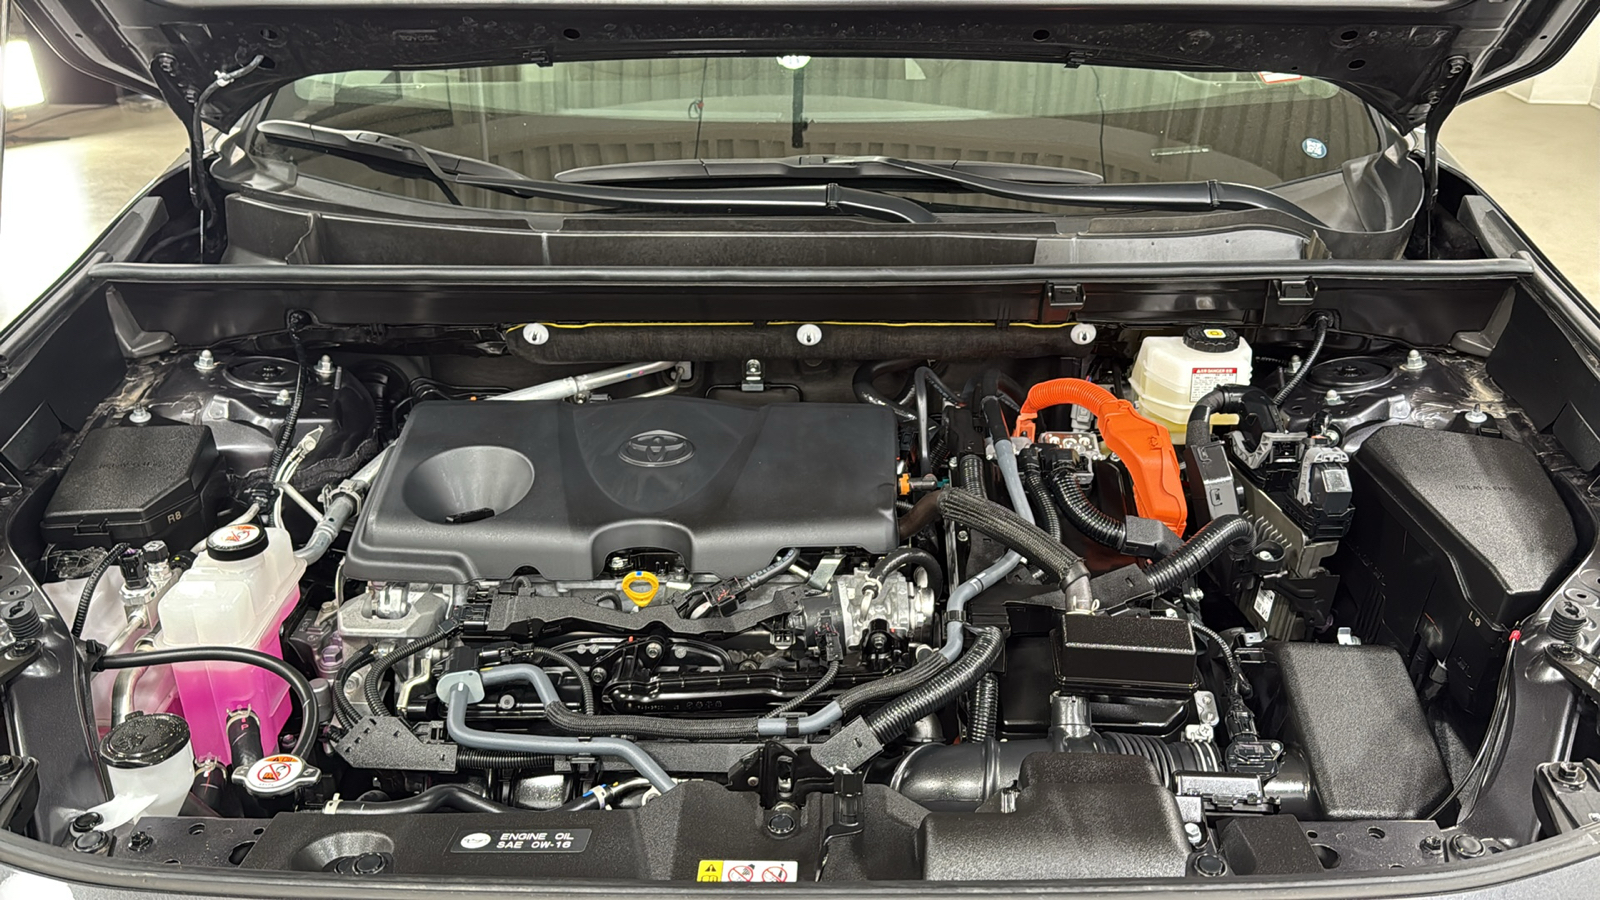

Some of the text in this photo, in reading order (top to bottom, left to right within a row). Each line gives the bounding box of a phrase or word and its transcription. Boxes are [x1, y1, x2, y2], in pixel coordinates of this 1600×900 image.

[167, 510, 182, 525] R8
[500, 832, 575, 841] ENGINE OIL
[496, 841, 524, 849] SAE
